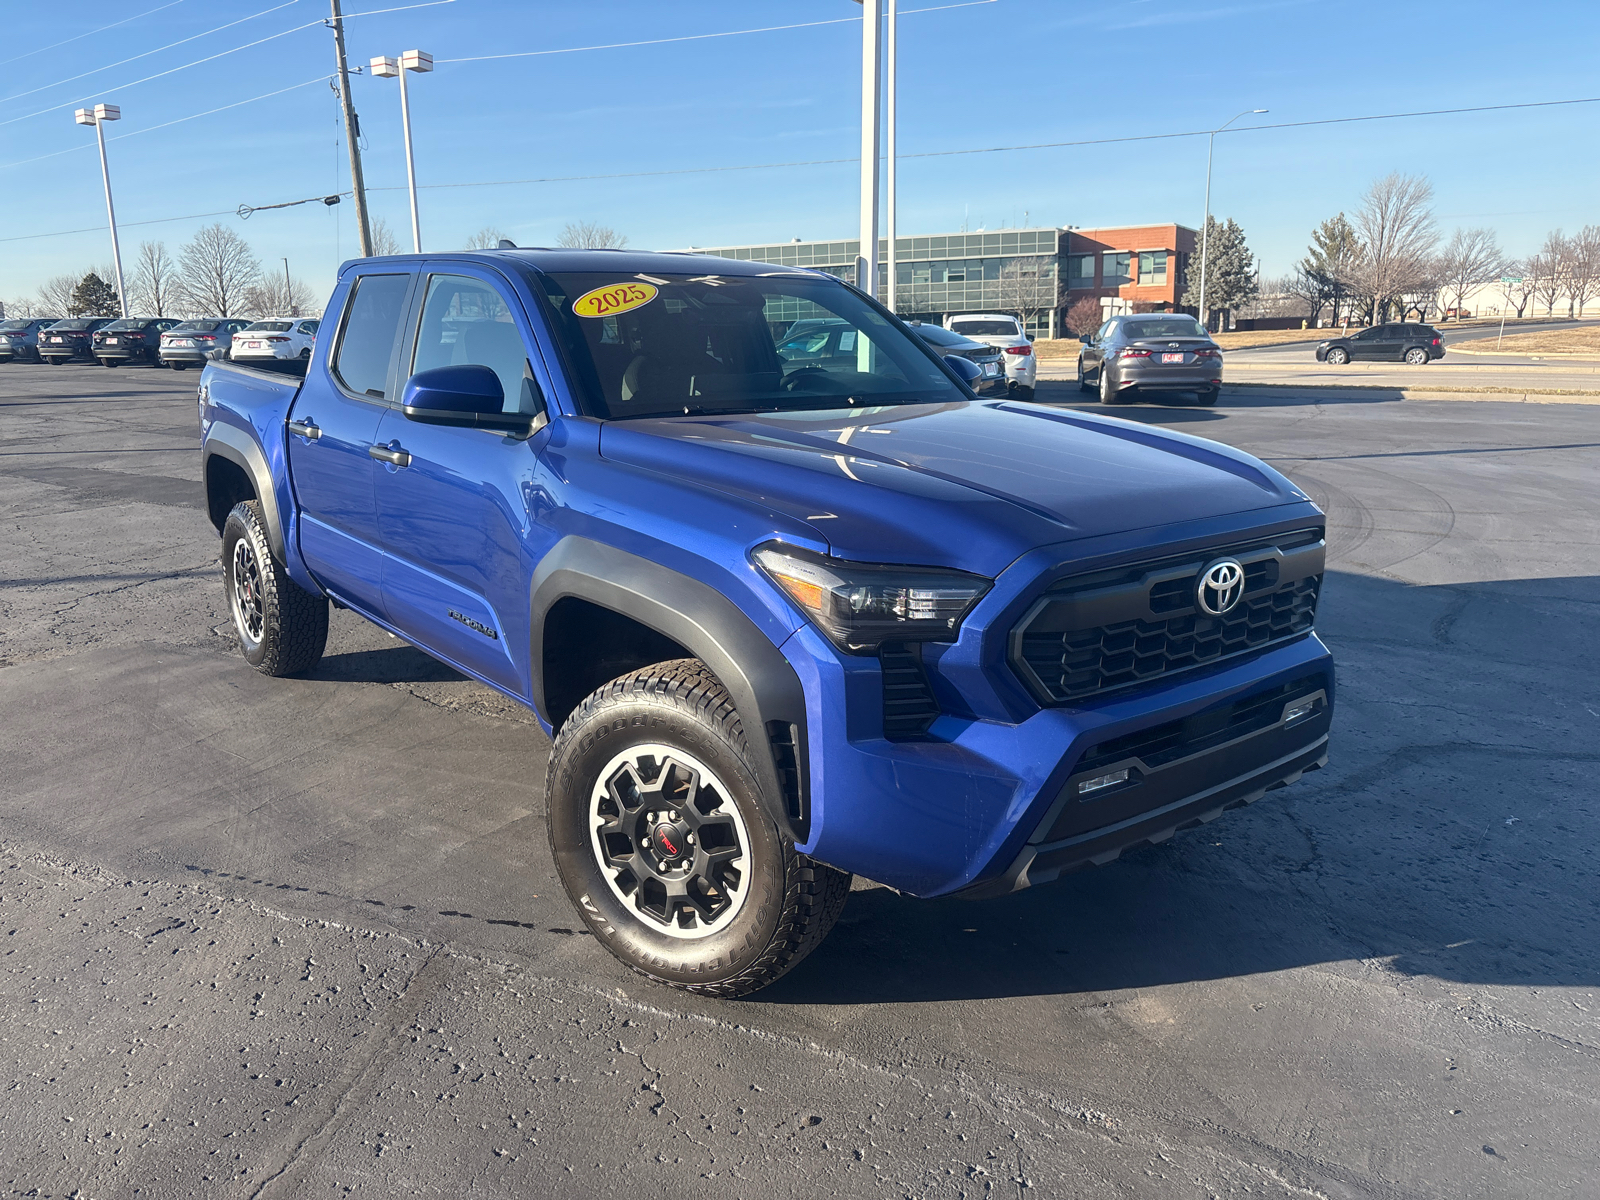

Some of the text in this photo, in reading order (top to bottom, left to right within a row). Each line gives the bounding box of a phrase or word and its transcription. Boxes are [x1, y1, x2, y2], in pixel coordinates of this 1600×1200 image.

[588, 285, 647, 314] 2025
[1163, 353, 1183, 361] ADAMS
[560, 713, 719, 794] BFGoodrich
[659, 829, 678, 854] TRD
[580, 893, 616, 940] T/A
